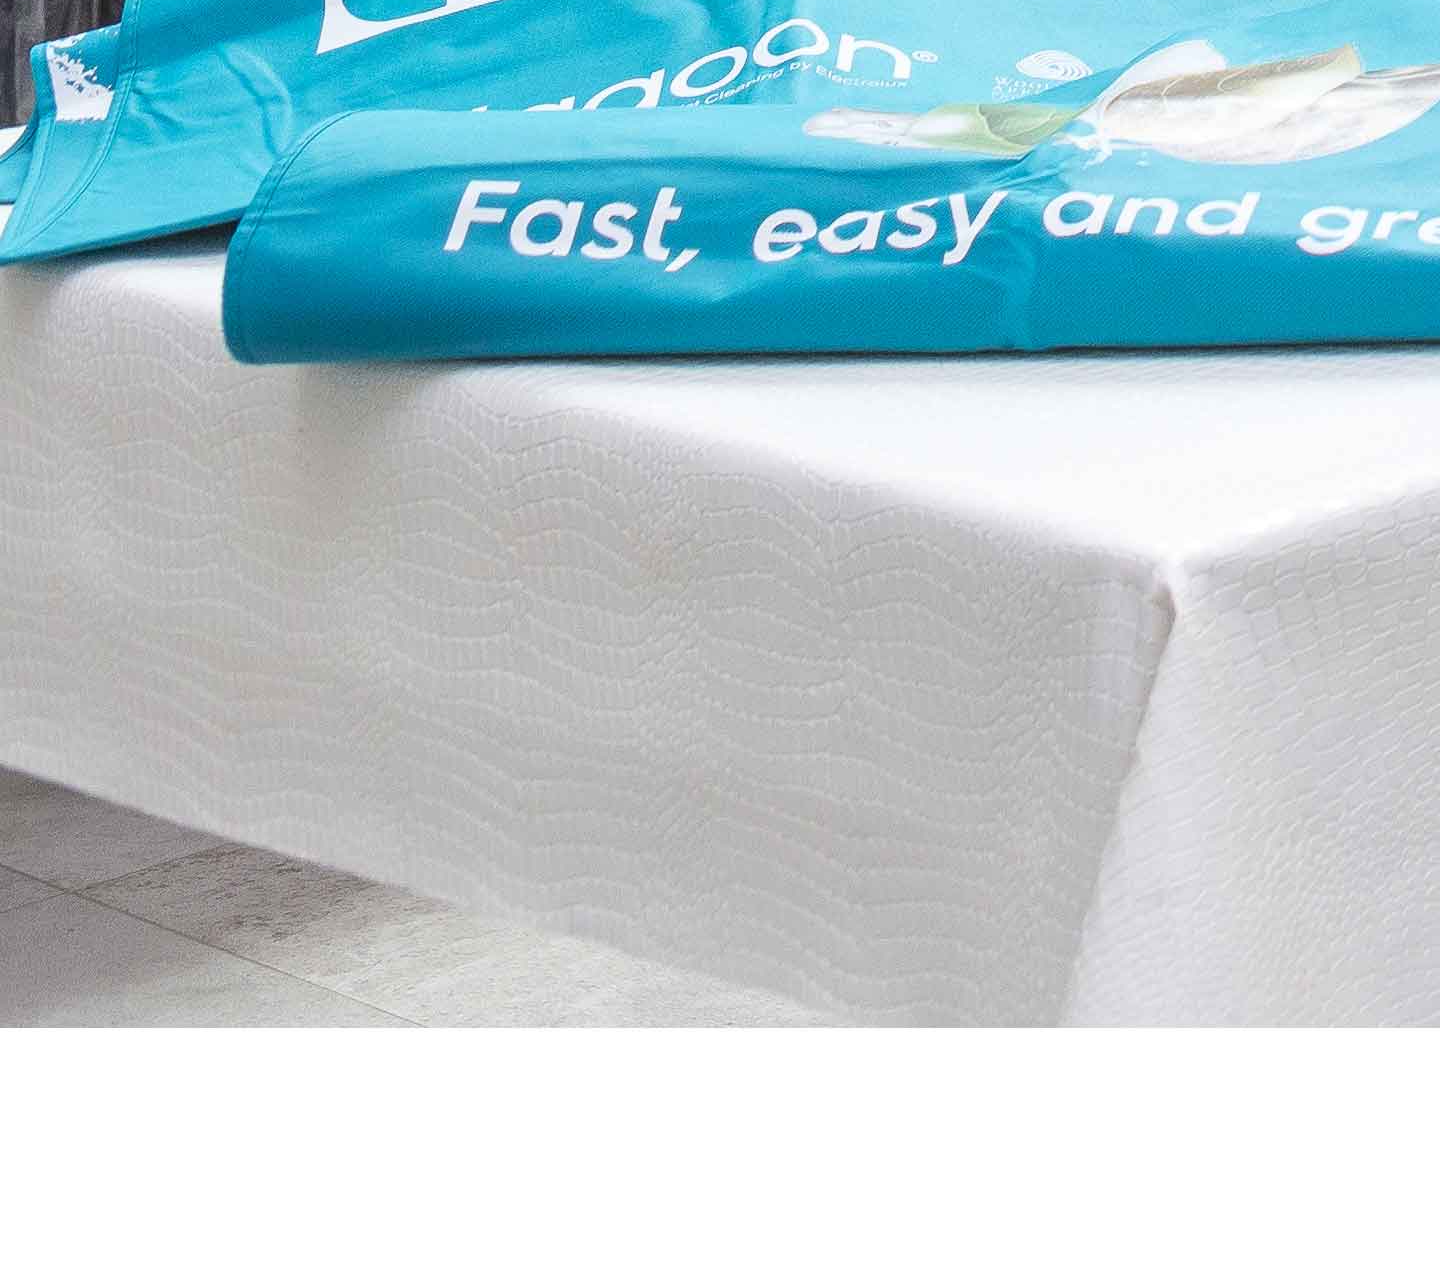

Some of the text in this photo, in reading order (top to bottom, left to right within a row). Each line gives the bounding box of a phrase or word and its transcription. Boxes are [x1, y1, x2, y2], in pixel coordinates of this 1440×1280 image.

[443, 179, 701, 273] Fast,
[752, 189, 1010, 267] easy
[1042, 190, 1262, 238] and
